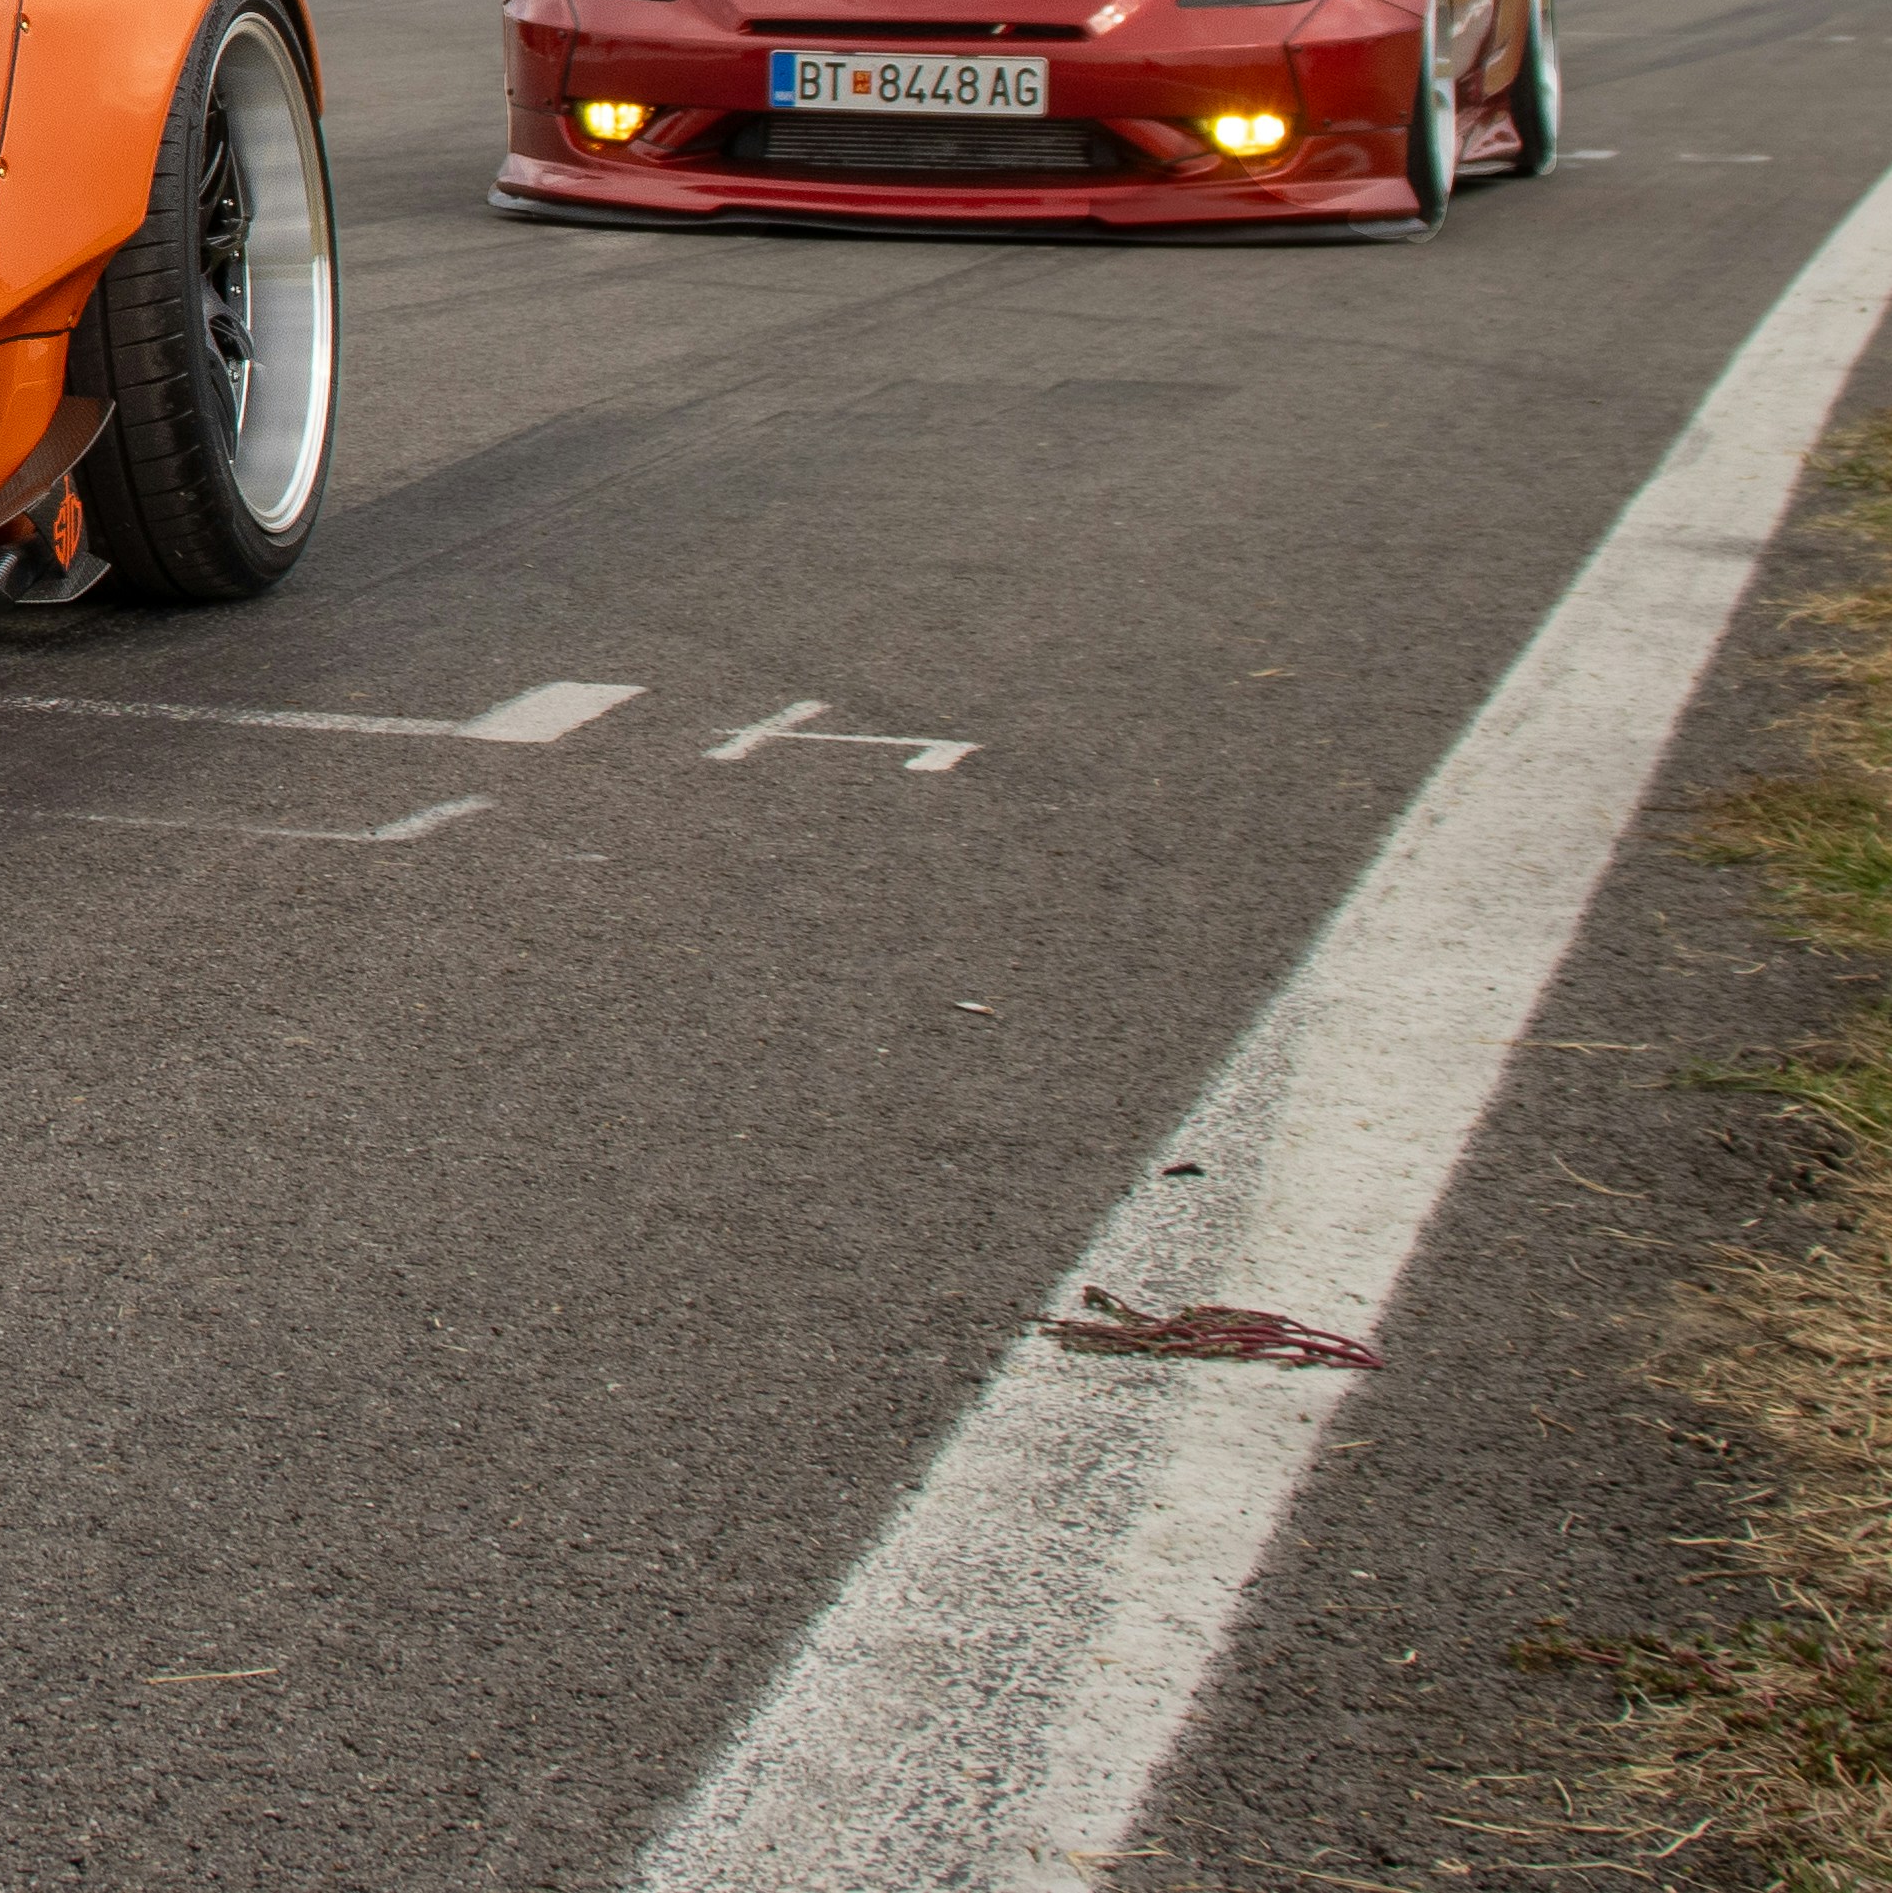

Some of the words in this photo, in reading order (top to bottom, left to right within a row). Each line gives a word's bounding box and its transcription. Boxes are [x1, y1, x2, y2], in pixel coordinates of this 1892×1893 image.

[800, 60, 847, 101] BT
[878, 63, 979, 106] 8448
[988, 66, 1039, 107] AG
